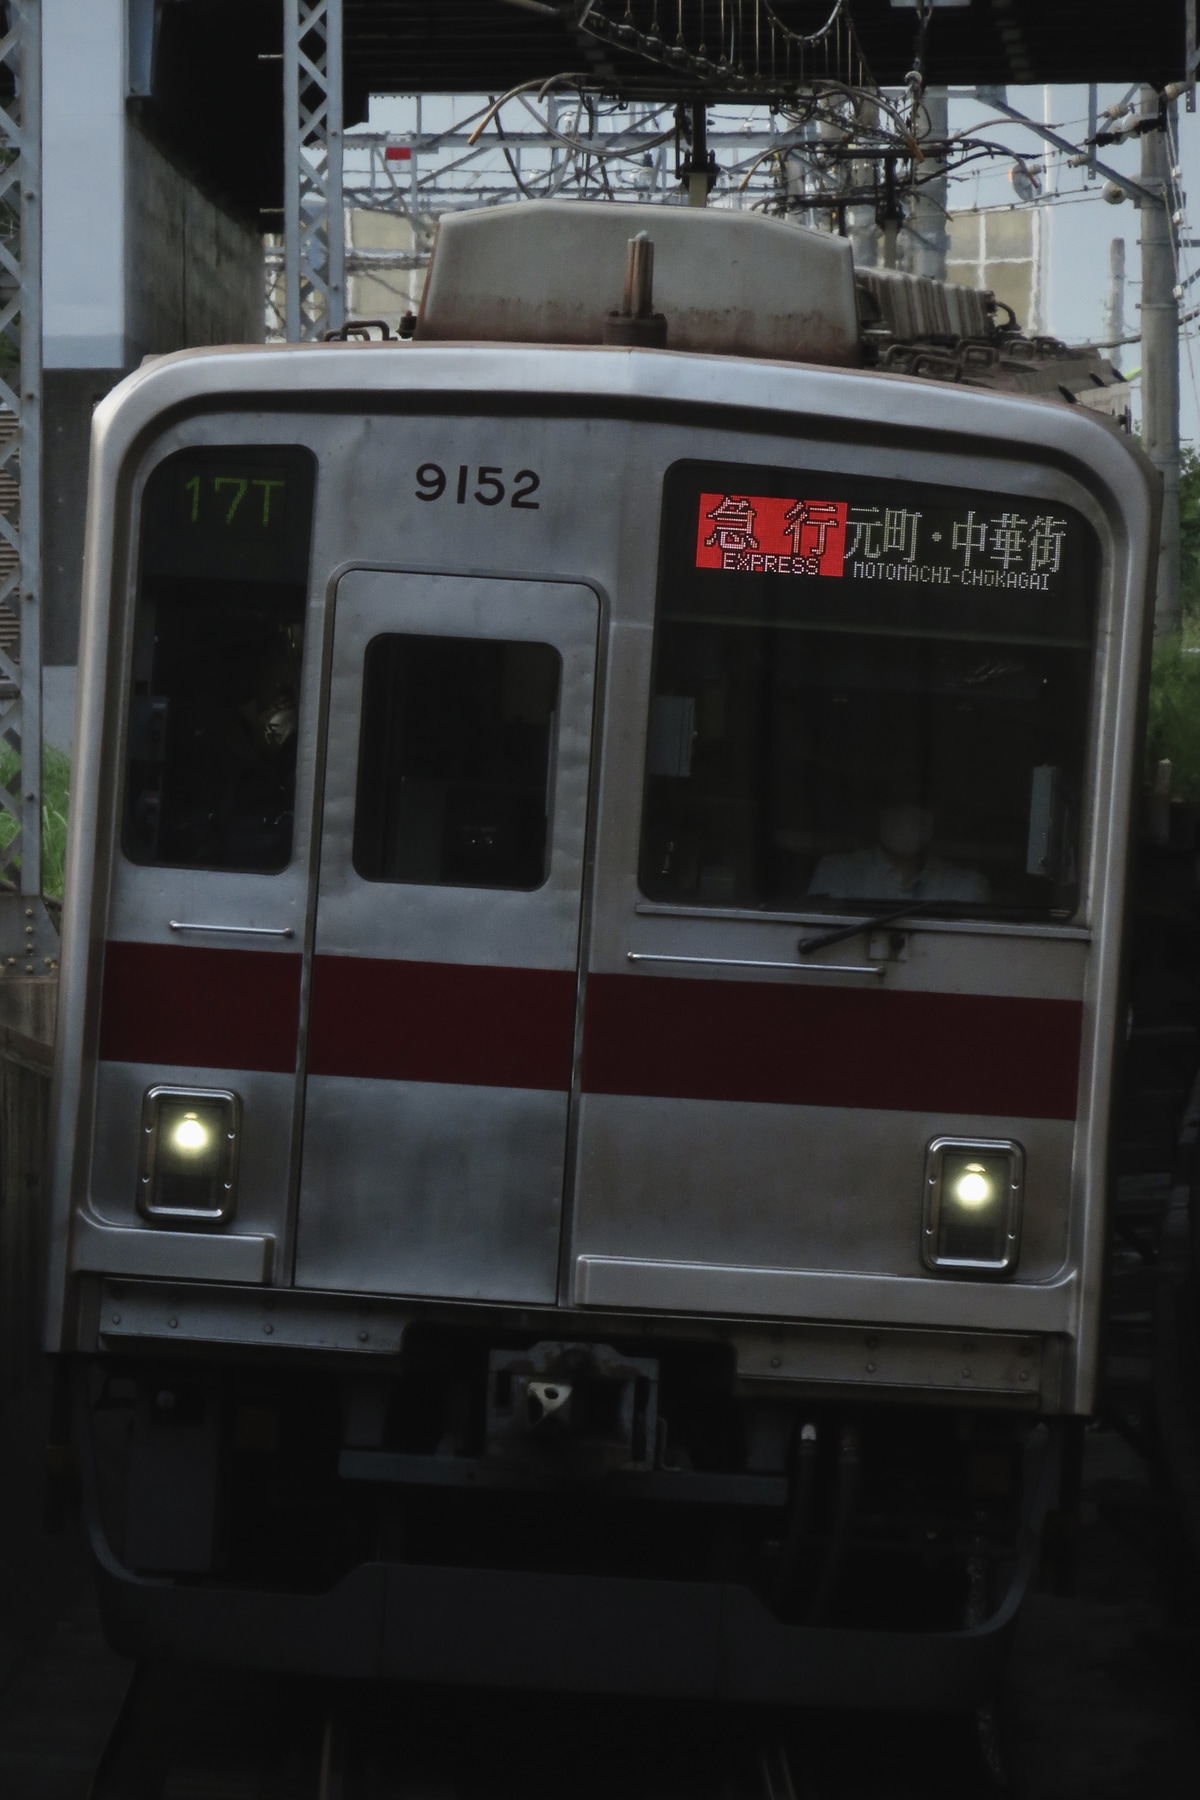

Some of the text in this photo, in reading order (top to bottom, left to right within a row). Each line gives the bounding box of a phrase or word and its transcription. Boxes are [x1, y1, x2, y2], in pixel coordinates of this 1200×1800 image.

[184, 476, 284, 526] 17T
[414, 463, 540, 508] 9152
[722, 553, 819, 575] EXPRESS
